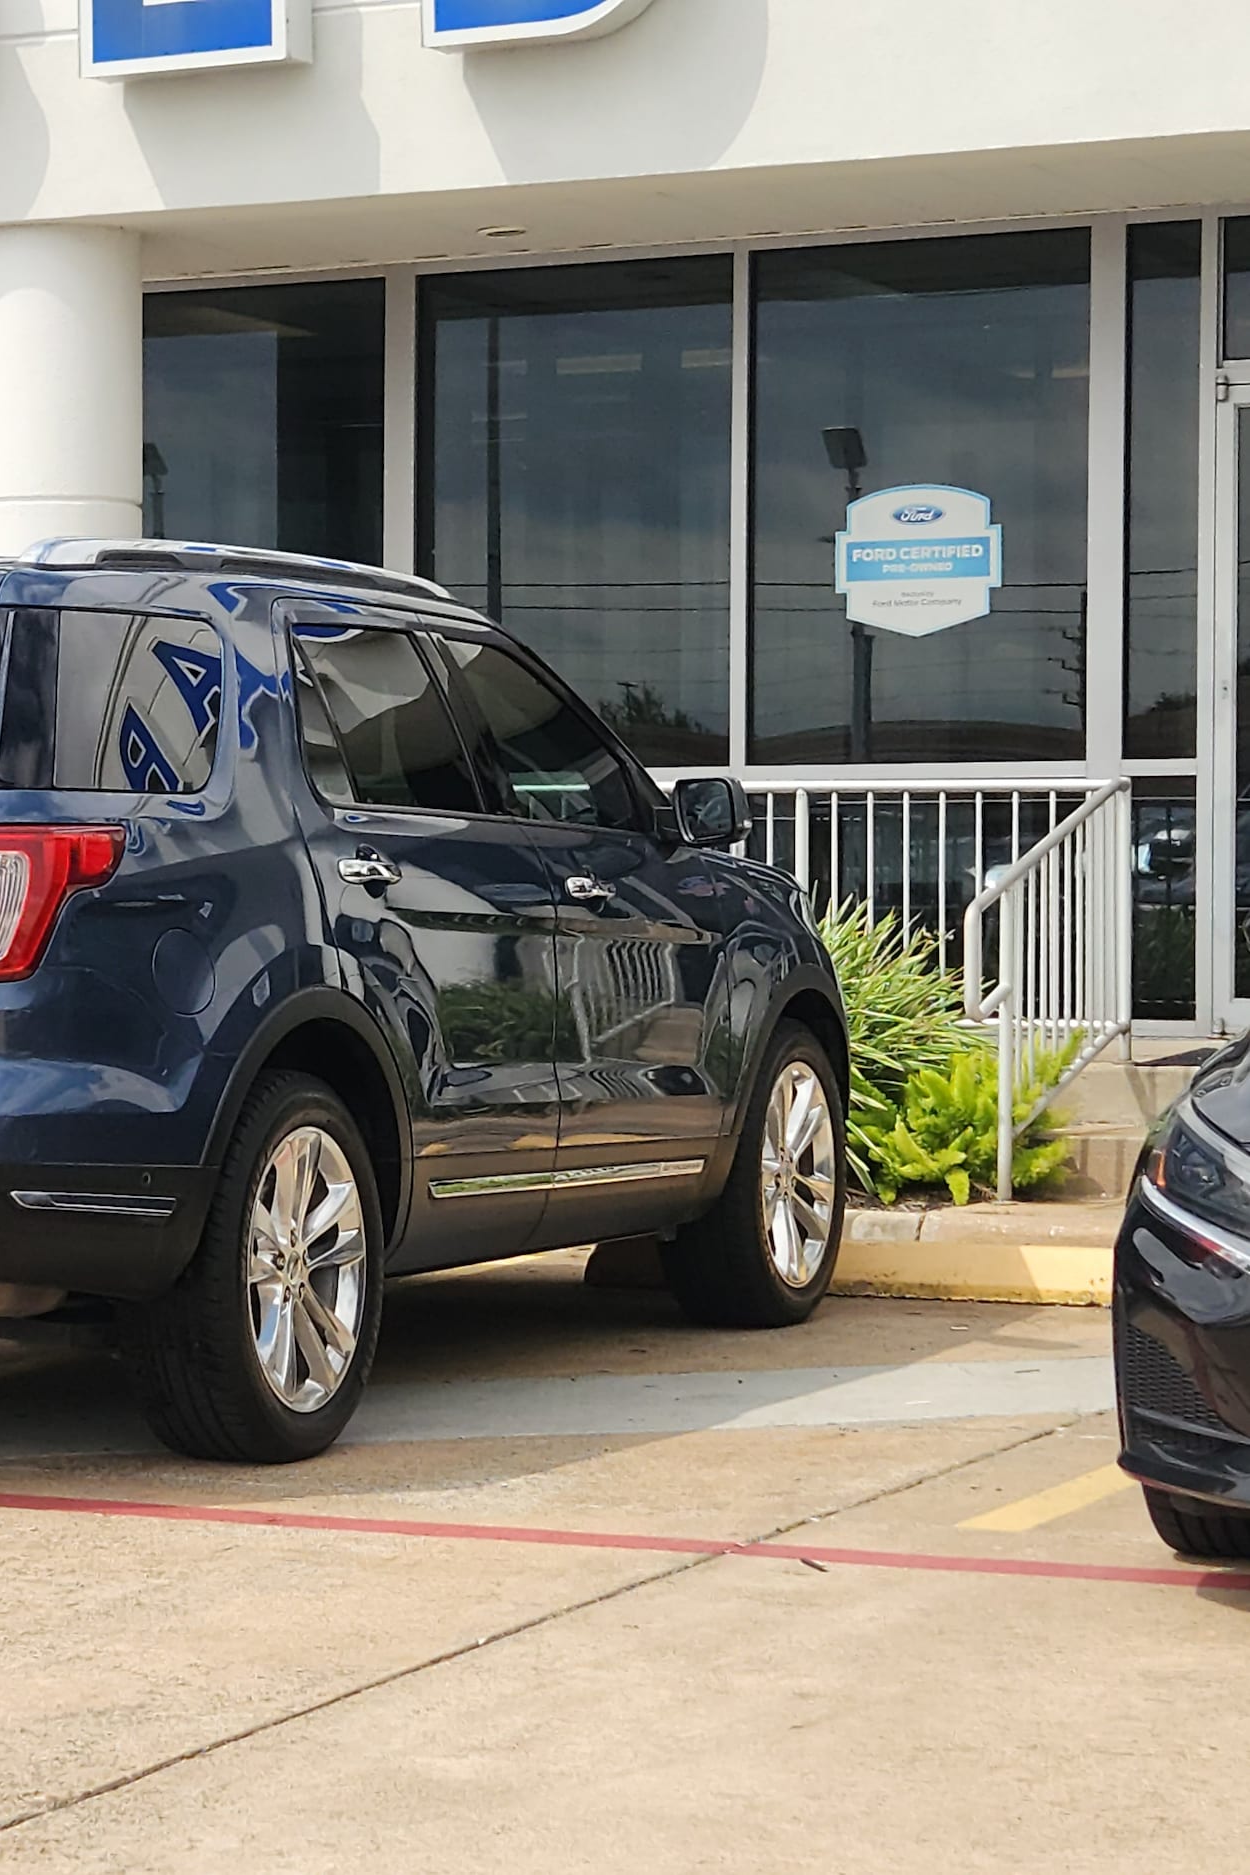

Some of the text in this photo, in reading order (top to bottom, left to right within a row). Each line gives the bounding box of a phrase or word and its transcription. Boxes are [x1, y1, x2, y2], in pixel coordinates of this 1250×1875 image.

[852, 544, 984, 563] FORD CERTIFIED
[882, 561, 954, 574] PRE-OWNED
